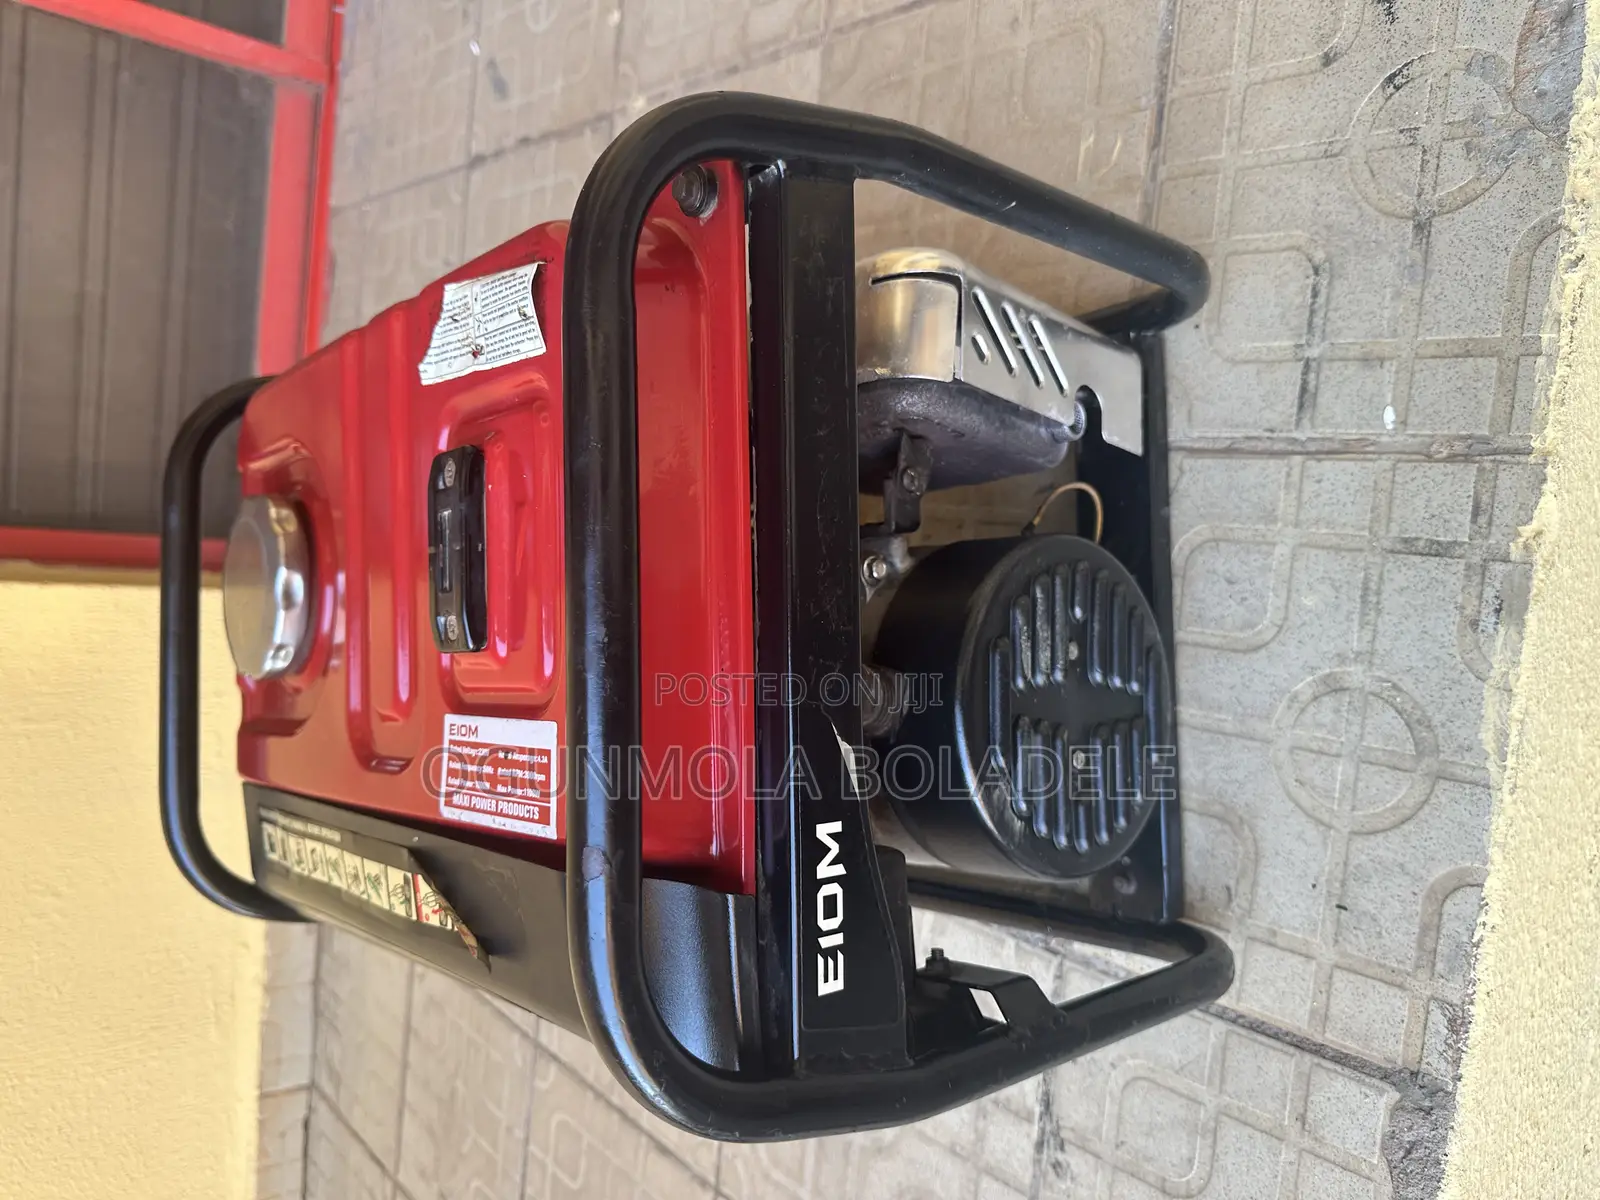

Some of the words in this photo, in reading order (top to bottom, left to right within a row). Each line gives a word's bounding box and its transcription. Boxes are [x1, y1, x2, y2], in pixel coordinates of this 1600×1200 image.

[449, 723, 479, 738] EIOM
[496, 784, 507, 793] Max
[453, 793, 470, 807] MAXI
[471, 796, 497, 813] POWER
[498, 800, 540, 819] PRODUCTS
[816, 821, 847, 997] EIOM
